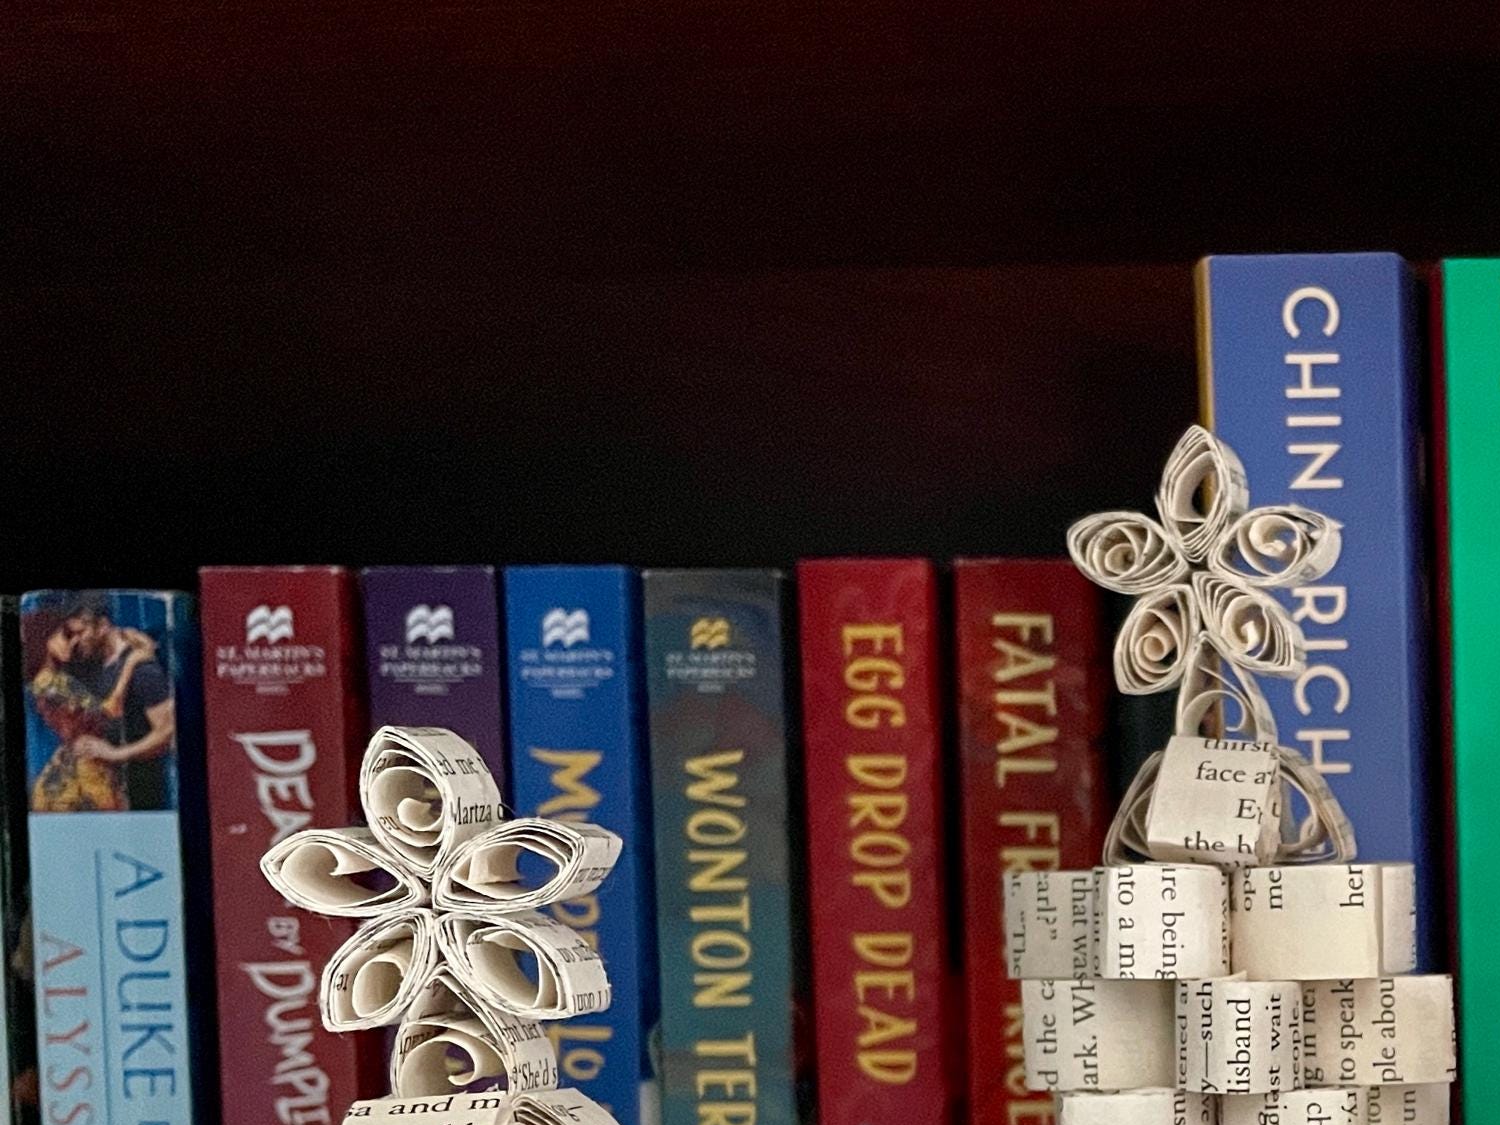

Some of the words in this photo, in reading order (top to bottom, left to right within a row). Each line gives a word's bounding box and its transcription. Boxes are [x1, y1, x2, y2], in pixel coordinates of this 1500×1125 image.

[1283, 287, 1344, 490] CHIN
[842, 622, 906, 729] EGG
[992, 612, 1059, 787] FATAL
[1292, 586, 1351, 773] RICH
[233, 728, 318, 835] DEA
[1196, 761, 1246, 784] face
[847, 754, 912, 909] DROP
[1184, 832, 1226, 853] the
[114, 853, 164, 898] A
[684, 749, 751, 1008] WONTON
[1268, 869, 1284, 910] me
[1339, 866, 1365, 908] her
[266, 916, 300, 957] BY
[1155, 912, 1185, 979] being
[115, 918, 177, 1102] DUKE
[853, 933, 918, 1084] DEAD
[1037, 1016, 1058, 1056] the
[1270, 993, 1282, 1052] wait
[1332, 979, 1363, 1050] speak
[1340, 1058, 1356, 1085] to
[392, 1097, 452, 1115] and
